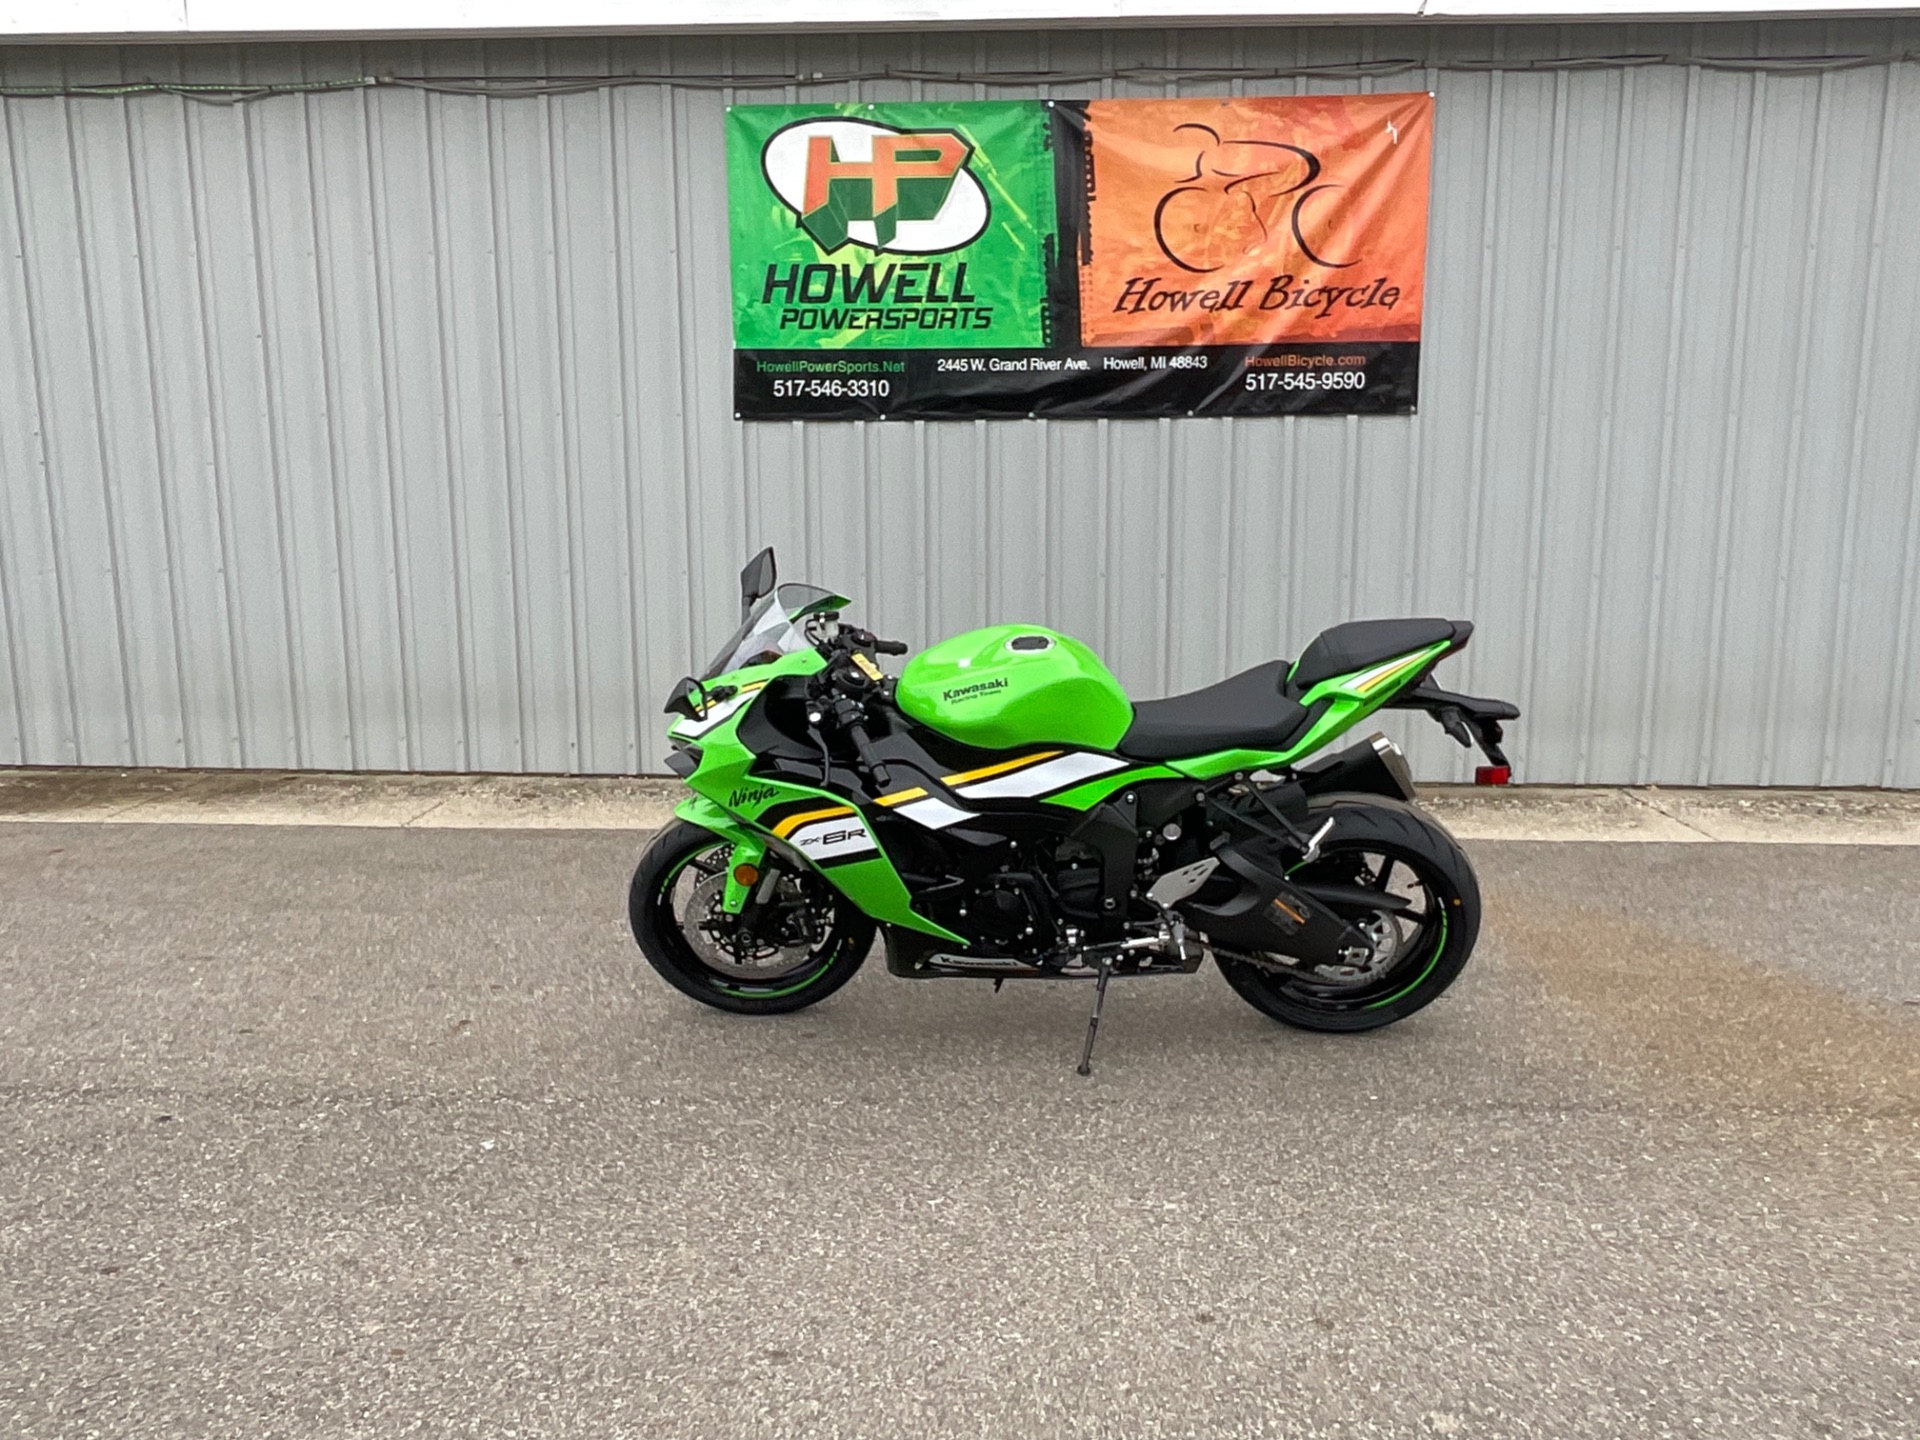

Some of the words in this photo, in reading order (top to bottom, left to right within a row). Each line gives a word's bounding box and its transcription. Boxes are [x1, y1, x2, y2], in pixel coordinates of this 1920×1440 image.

[802, 134, 970, 249] HP
[762, 263, 975, 304] HOWELL
[1113, 276, 1254, 314] Howell
[1259, 275, 1400, 319] Bicycle
[780, 307, 993, 330] POWERSPORTS
[756, 360, 905, 375] HowellPowerSports.Net
[937, 359, 968, 371] 2445
[970, 358, 986, 371] W.
[989, 358, 1027, 371] Grand
[1030, 358, 1062, 371] River
[1064, 357, 1090, 370] Ave.
[1103, 356, 1147, 371] Howell,
[1151, 356, 1166, 369] MI
[1169, 356, 1208, 369] 48843
[1244, 354, 1366, 369] HowellBicycle.com
[773, 379, 890, 397] 517-546-3310
[1245, 371, 1366, 391] 517-545-9590
[943, 677, 1008, 701] Kawasaki
[728, 785, 780, 808] Ninja
